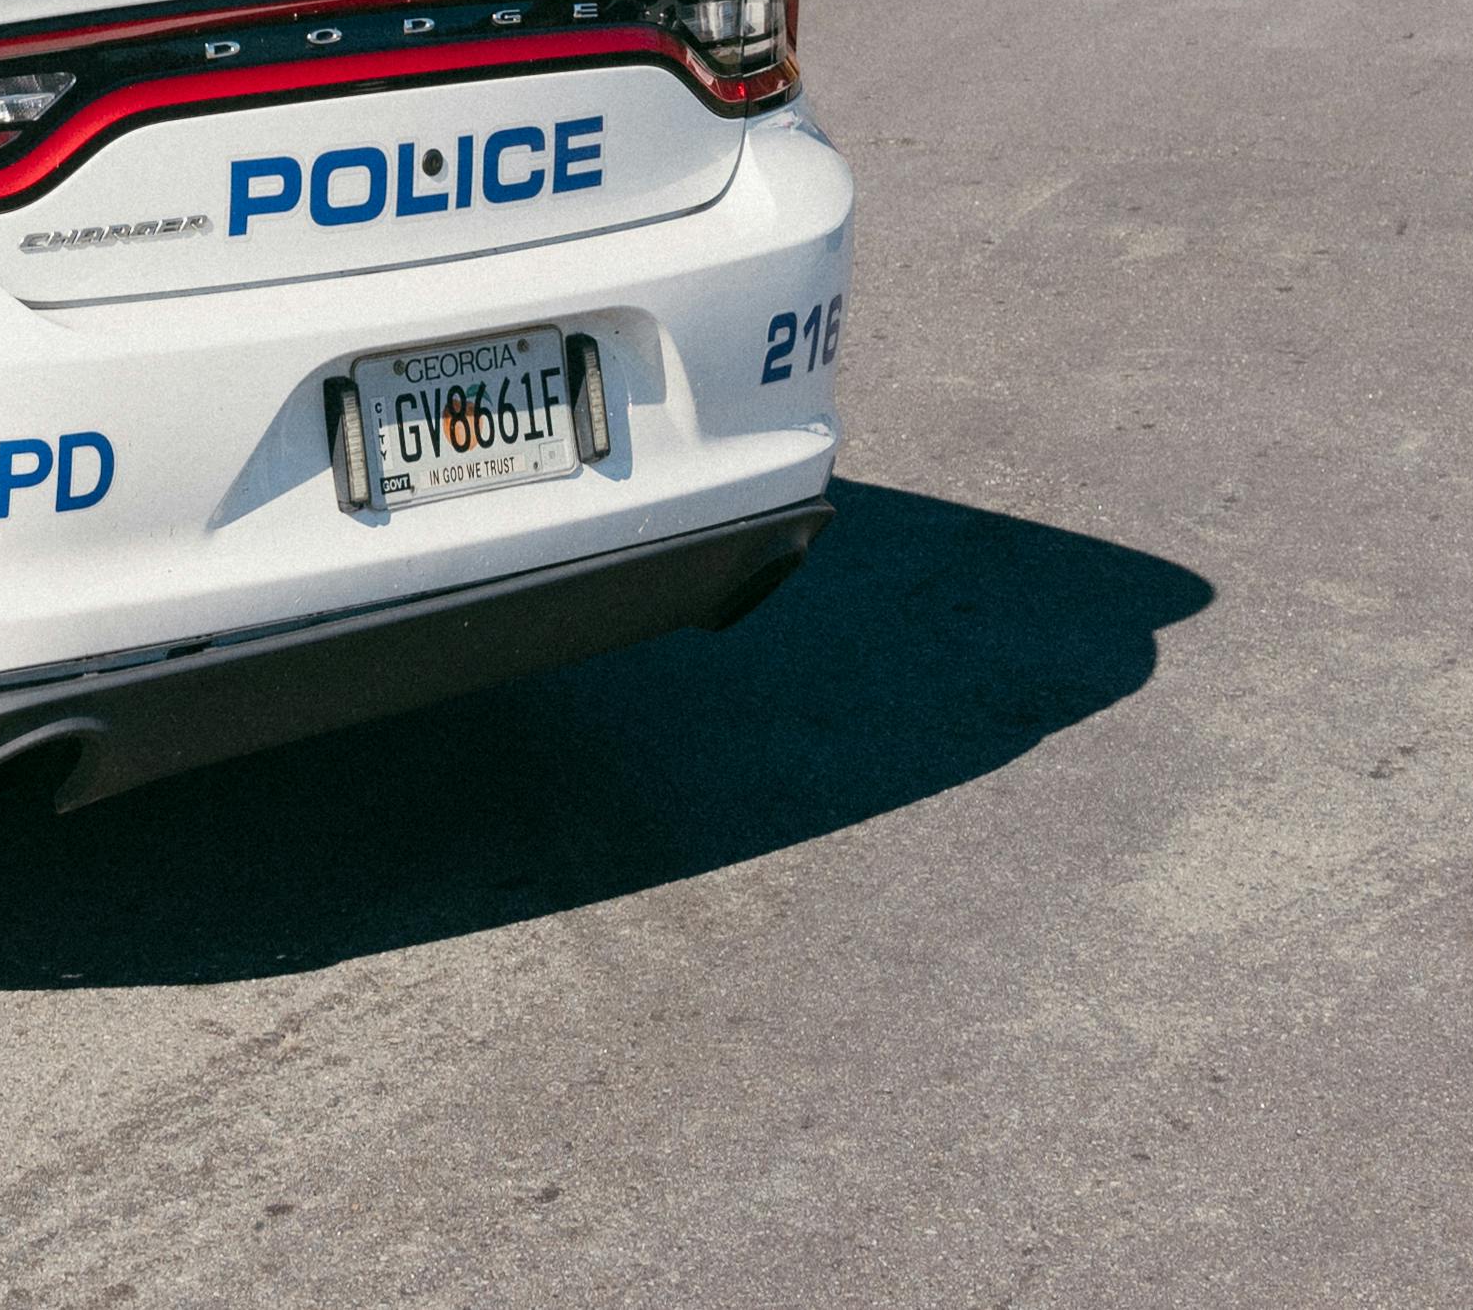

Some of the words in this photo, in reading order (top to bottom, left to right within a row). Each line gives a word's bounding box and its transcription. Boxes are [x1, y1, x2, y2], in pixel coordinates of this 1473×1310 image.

[204, 3, 598, 59] DODGE
[228, 115, 604, 237] POLICE
[19, 214, 211, 253] CHARGER
[406, 344, 516, 383] GEORGIA
[760, 293, 843, 385] 216
[374, 402, 388, 461] CITY
[395, 367, 561, 463] GV8661F
[382, 476, 409, 493] GOVT
[429, 469, 440, 486] IN
[442, 465, 465, 484] GOD
[466, 462, 482, 480] WE
[484, 456, 516, 476] TRUST
